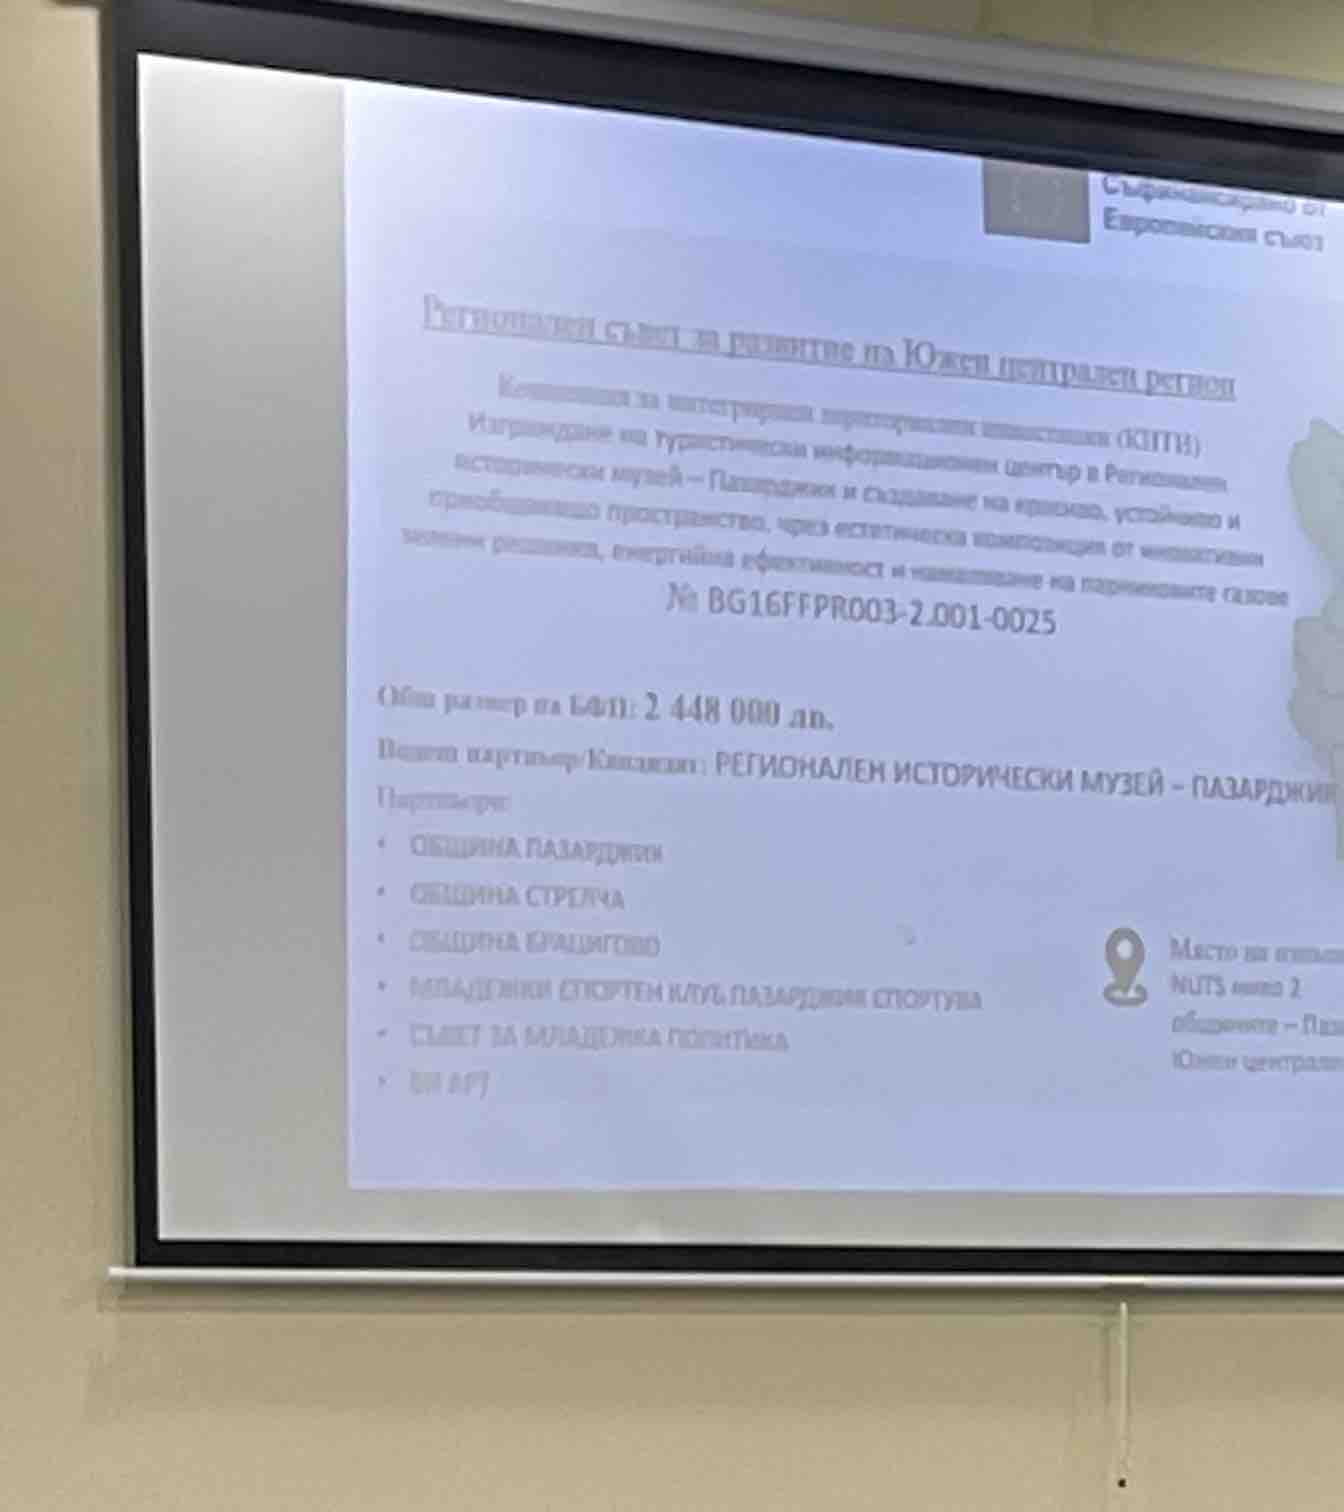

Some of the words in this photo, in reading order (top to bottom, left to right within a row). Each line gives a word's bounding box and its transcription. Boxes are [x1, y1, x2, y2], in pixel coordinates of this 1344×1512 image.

[904, 337, 990, 376] Южен
[1146, 369, 1237, 400] регион
[707, 585, 1058, 635] BG16FFPR003-2.001-0025
[644, 691, 662, 722] 2
[669, 694, 721, 725] 448
[730, 697, 781, 728] 000
[715, 750, 886, 785] РЕГИОНАЛЕН
[893, 759, 1075, 793] ИСТОРИЧЕСКИ
[1080, 768, 1164, 798] МУЗЕЙ
[1191, 773, 1337, 807] ПАЗАРДЖИК
[526, 885, 625, 911] СТРЕЛЧА
[1170, 976, 1226, 998] NUTS
[1290, 977, 1302, 998] 2
